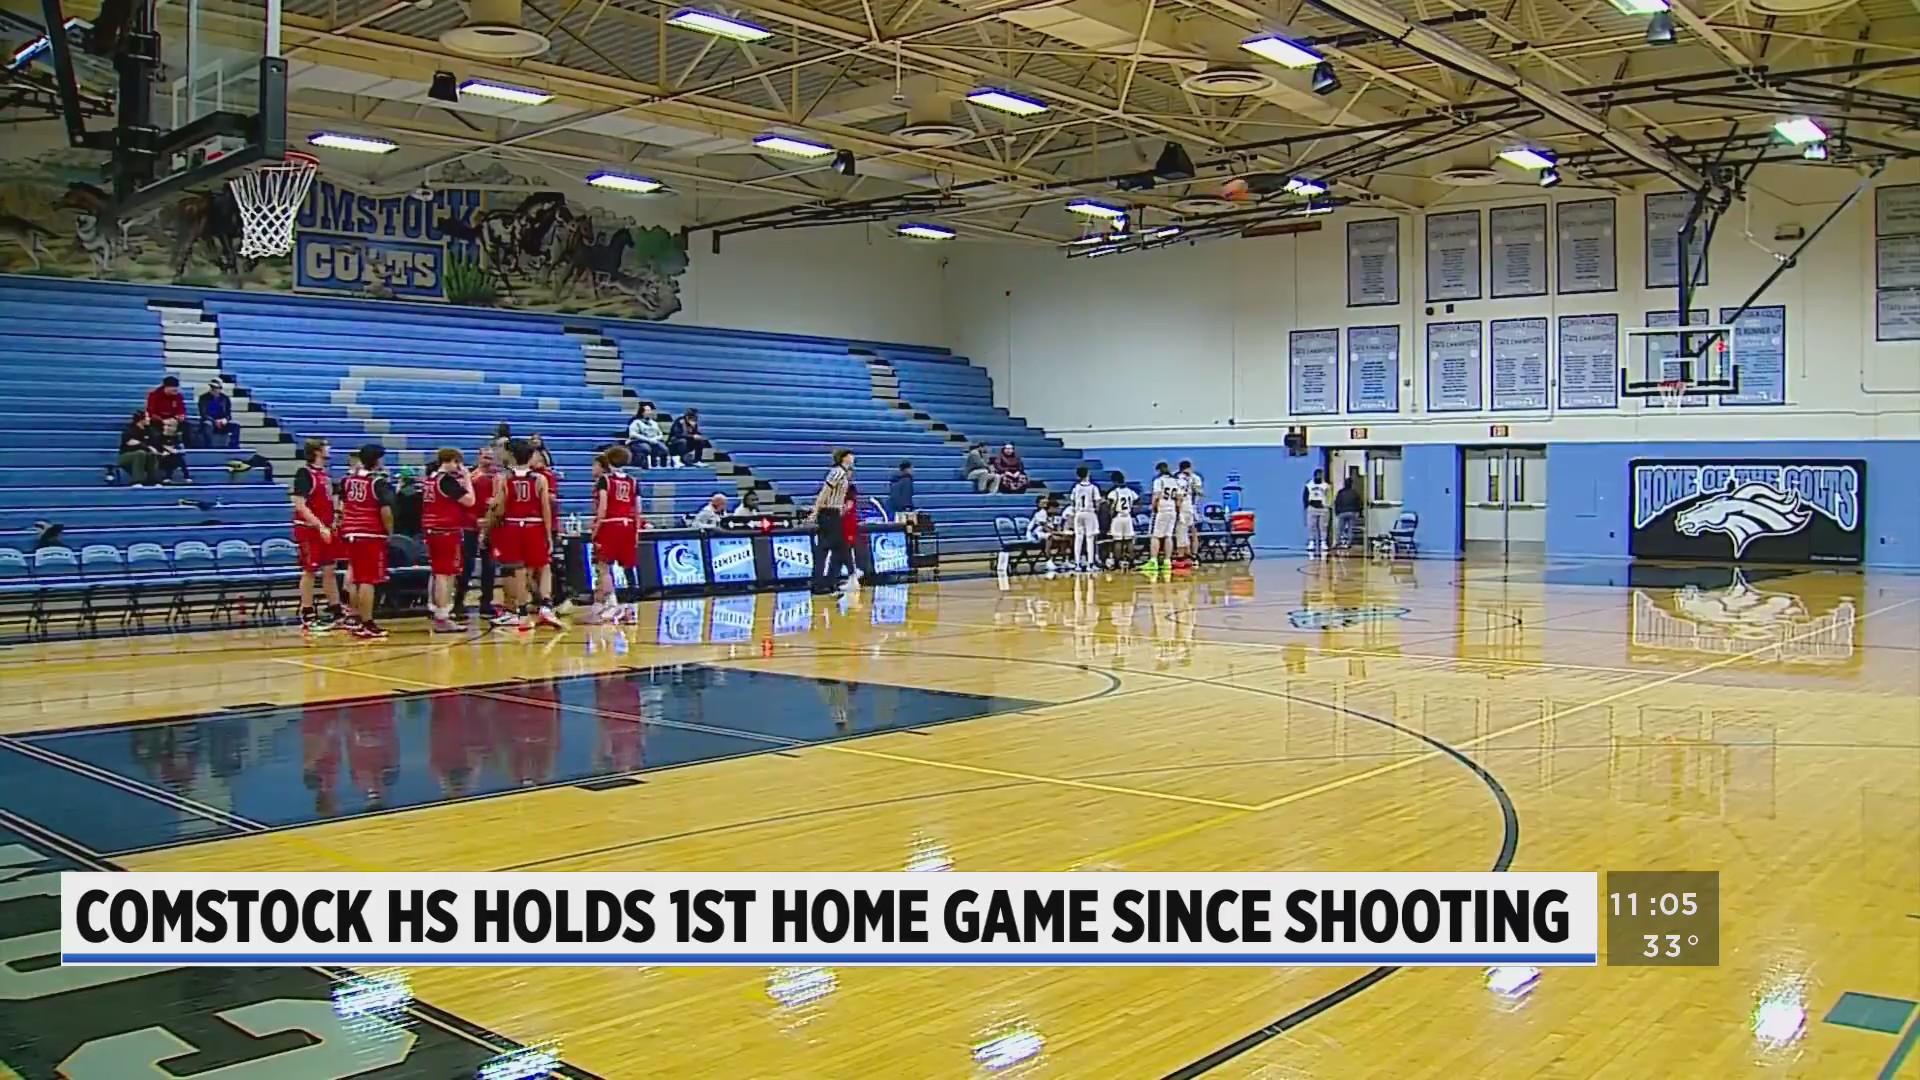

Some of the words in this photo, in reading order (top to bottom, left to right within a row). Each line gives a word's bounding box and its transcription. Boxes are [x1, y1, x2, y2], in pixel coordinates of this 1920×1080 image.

[296, 180, 481, 263] OMSTOCK
[512, 480, 531, 502] 10
[1080, 495, 1086, 508] 1
[1637, 467, 1698, 527] HOME
[1702, 467, 1732, 491] OF
[1734, 467, 1780, 490] THE
[1785, 467, 1856, 528] COLTS
[776, 546, 810, 565] COLTS
